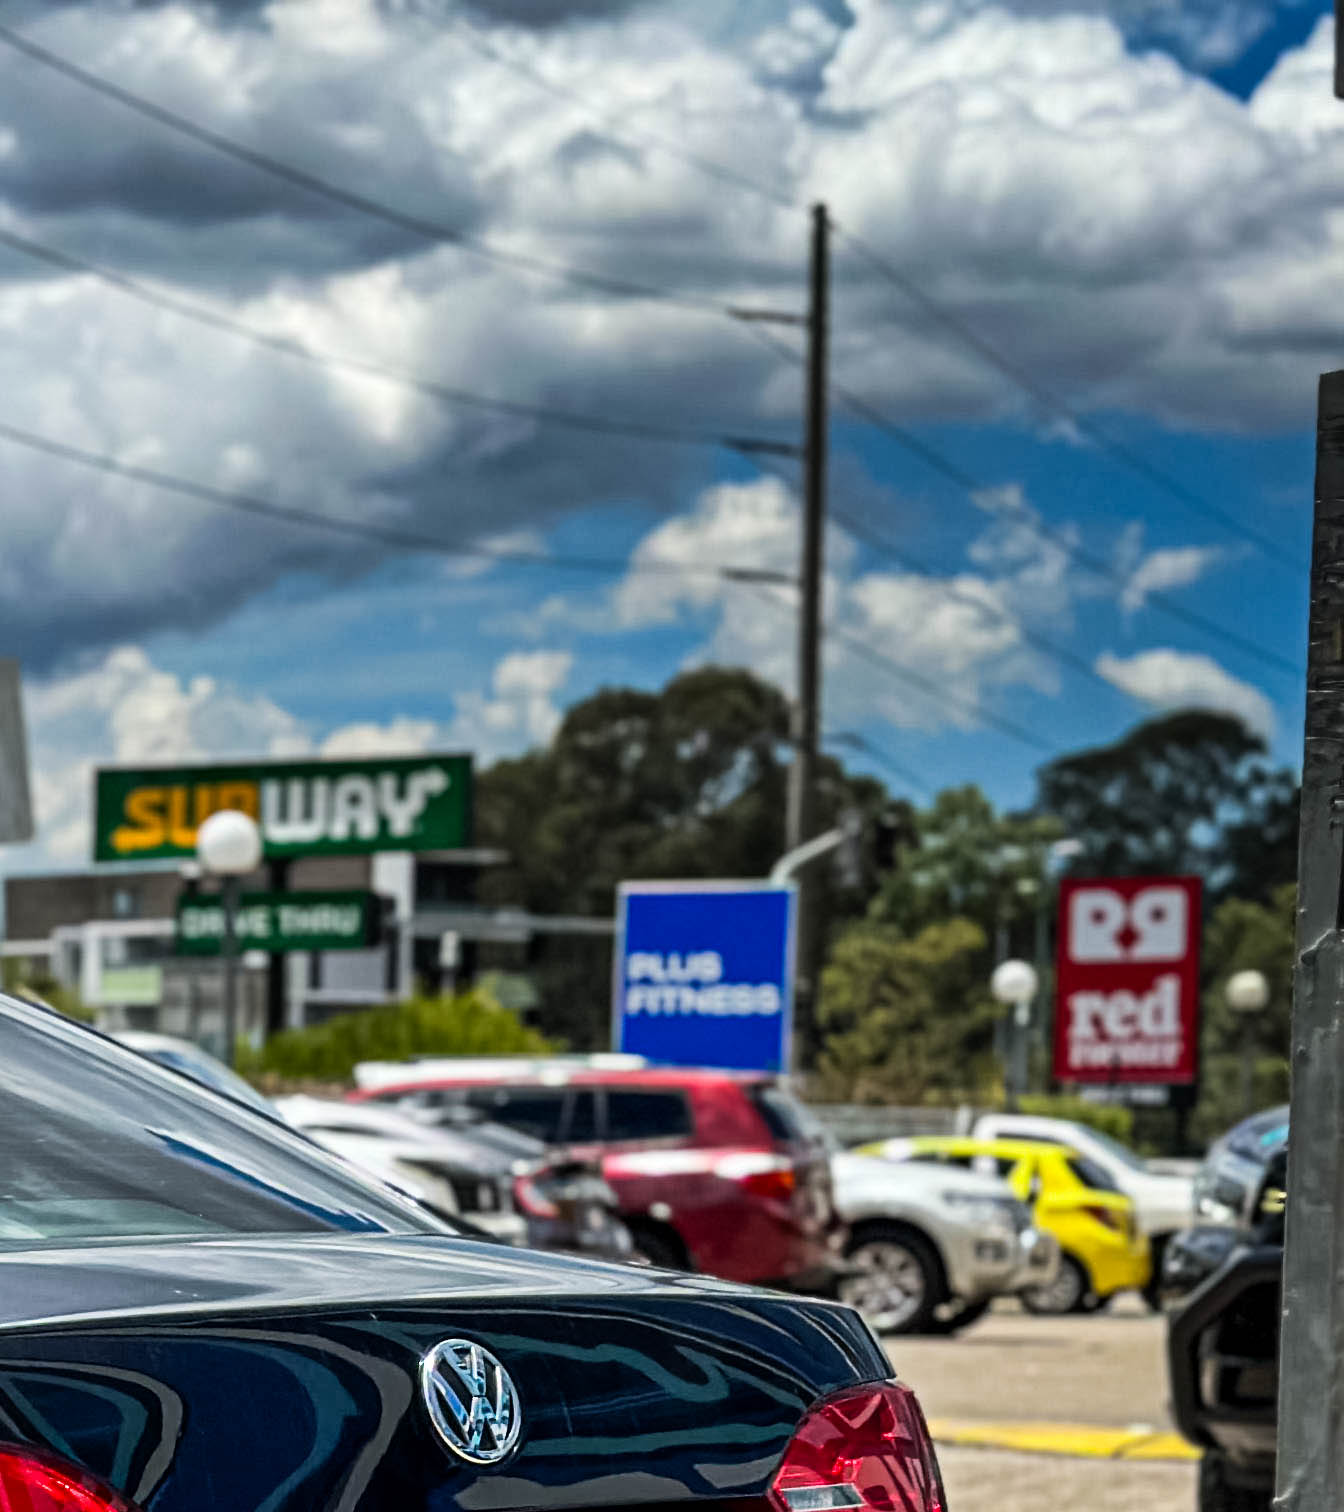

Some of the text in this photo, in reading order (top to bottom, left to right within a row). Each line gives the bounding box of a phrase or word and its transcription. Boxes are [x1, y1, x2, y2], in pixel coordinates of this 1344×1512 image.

[278, 903, 362, 937] THRU
[627, 951, 722, 982] PLUS
[626, 983, 780, 1016] FITNESS
[1068, 972, 1183, 1038] red
